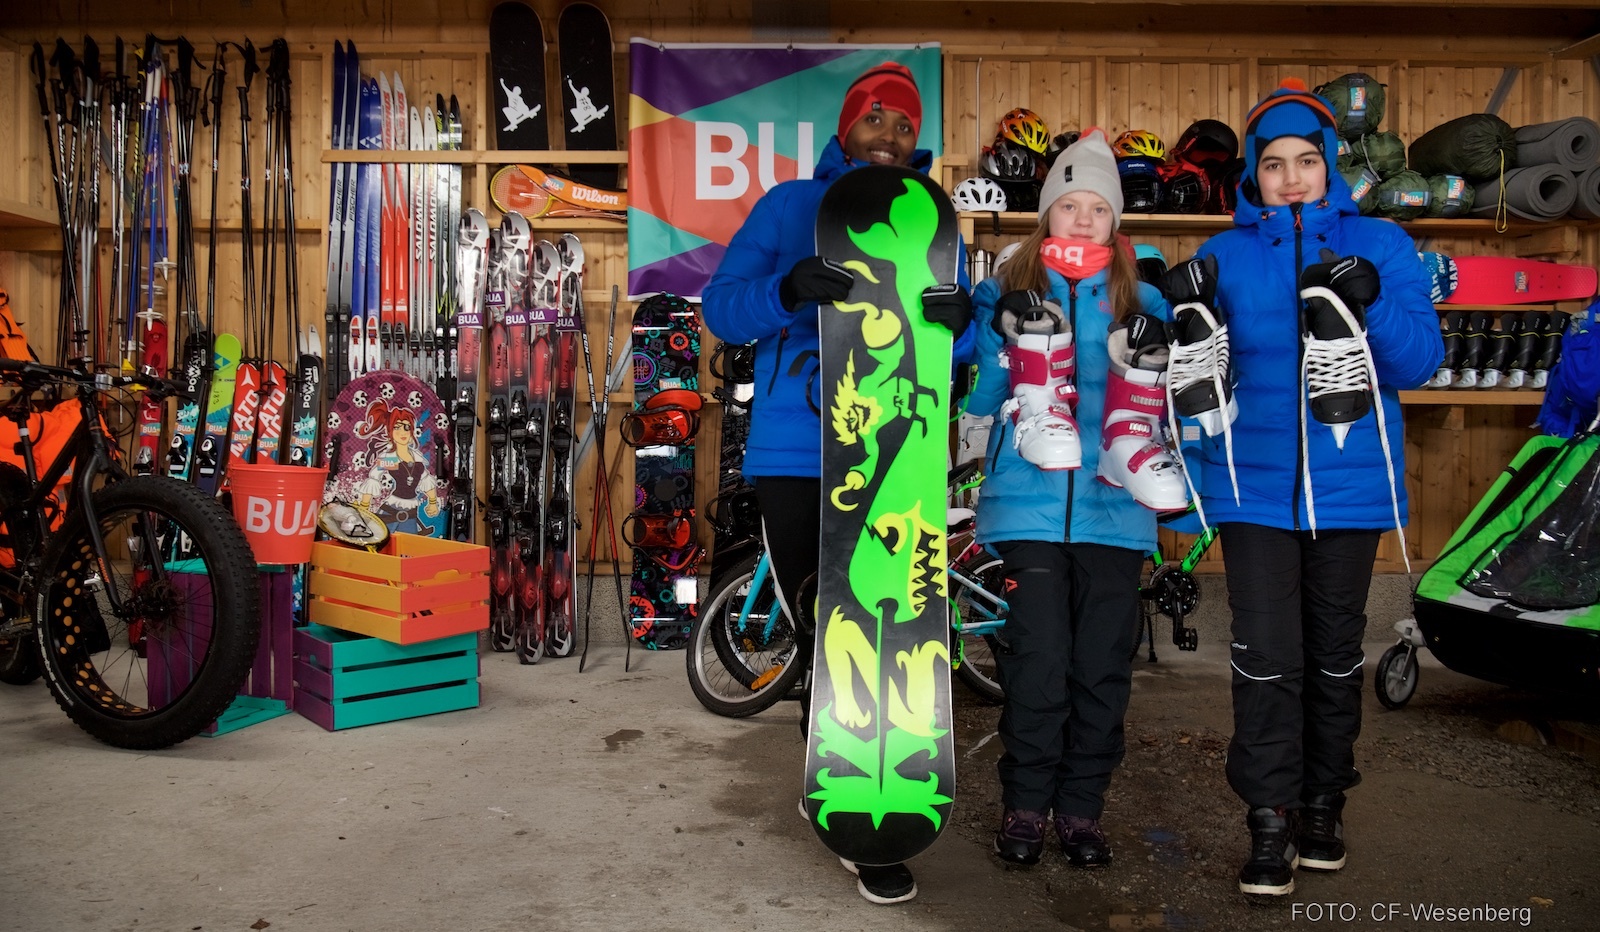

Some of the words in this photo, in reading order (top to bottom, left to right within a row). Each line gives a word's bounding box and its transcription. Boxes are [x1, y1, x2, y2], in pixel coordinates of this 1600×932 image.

[1354, 91, 1363, 106] BUA
[695, 121, 813, 200] BU
[571, 186, 619, 205] Wilson
[1354, 185, 1367, 199] BUA
[1453, 182, 1461, 196] BUA
[335, 179, 343, 222] FISCHER
[349, 179, 357, 222] FISCHER
[415, 185, 424, 260] SALOMON
[429, 184, 438, 260] SALOMON
[1449, 258, 1458, 291] BAM
[1518, 274, 1527, 290] BUA
[458, 315, 480, 324] BUA
[505, 314, 527, 325] BUA
[529, 310, 546, 320] BUA
[556, 318, 575, 327] BUA
[662, 381, 677, 389] BUA
[259, 388, 286, 428] ATO
[142, 425, 157, 433] BUA
[208, 424, 223, 432] BUA
[233, 433, 248, 441] BUA
[259, 440, 274, 448] BUA
[380, 460, 395, 468] BUA
[246, 496, 318, 536] BUA
